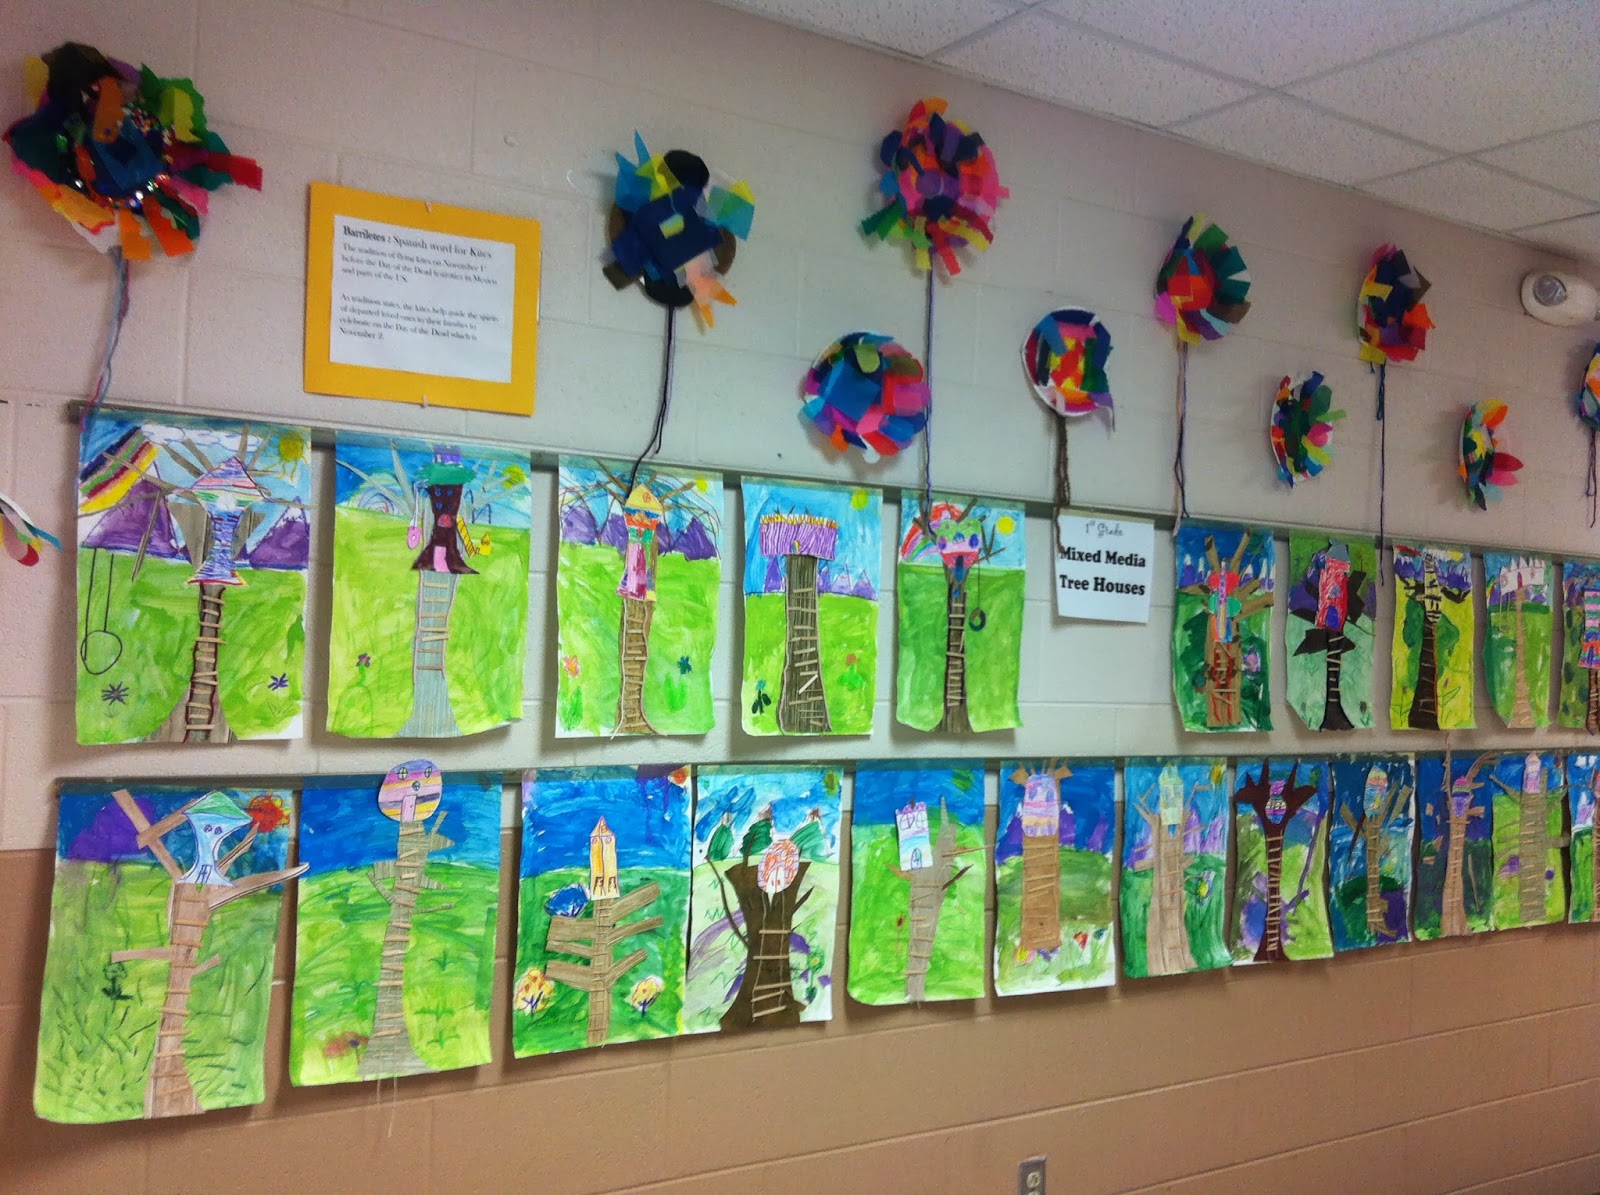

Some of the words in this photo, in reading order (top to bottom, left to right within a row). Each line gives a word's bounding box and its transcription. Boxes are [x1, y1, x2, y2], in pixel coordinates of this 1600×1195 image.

[393, 235, 428, 249] Spanish
[430, 243, 452, 254] word
[454, 245, 466, 255] for
[470, 247, 492, 258] Kites
[343, 242, 355, 252] The
[443, 259, 478, 272] November
[342, 267, 355, 275] and
[414, 266, 433, 276] Dead
[473, 274, 498, 285] Mexico
[432, 306, 447, 316] help
[431, 327, 449, 338] Dead
[1097, 522, 1124, 538] Grade
[1060, 546, 1101, 563] Mixed
[1104, 550, 1146, 568] Media
[1059, 574, 1089, 591] Tree
[1093, 576, 1146, 596] Houses
